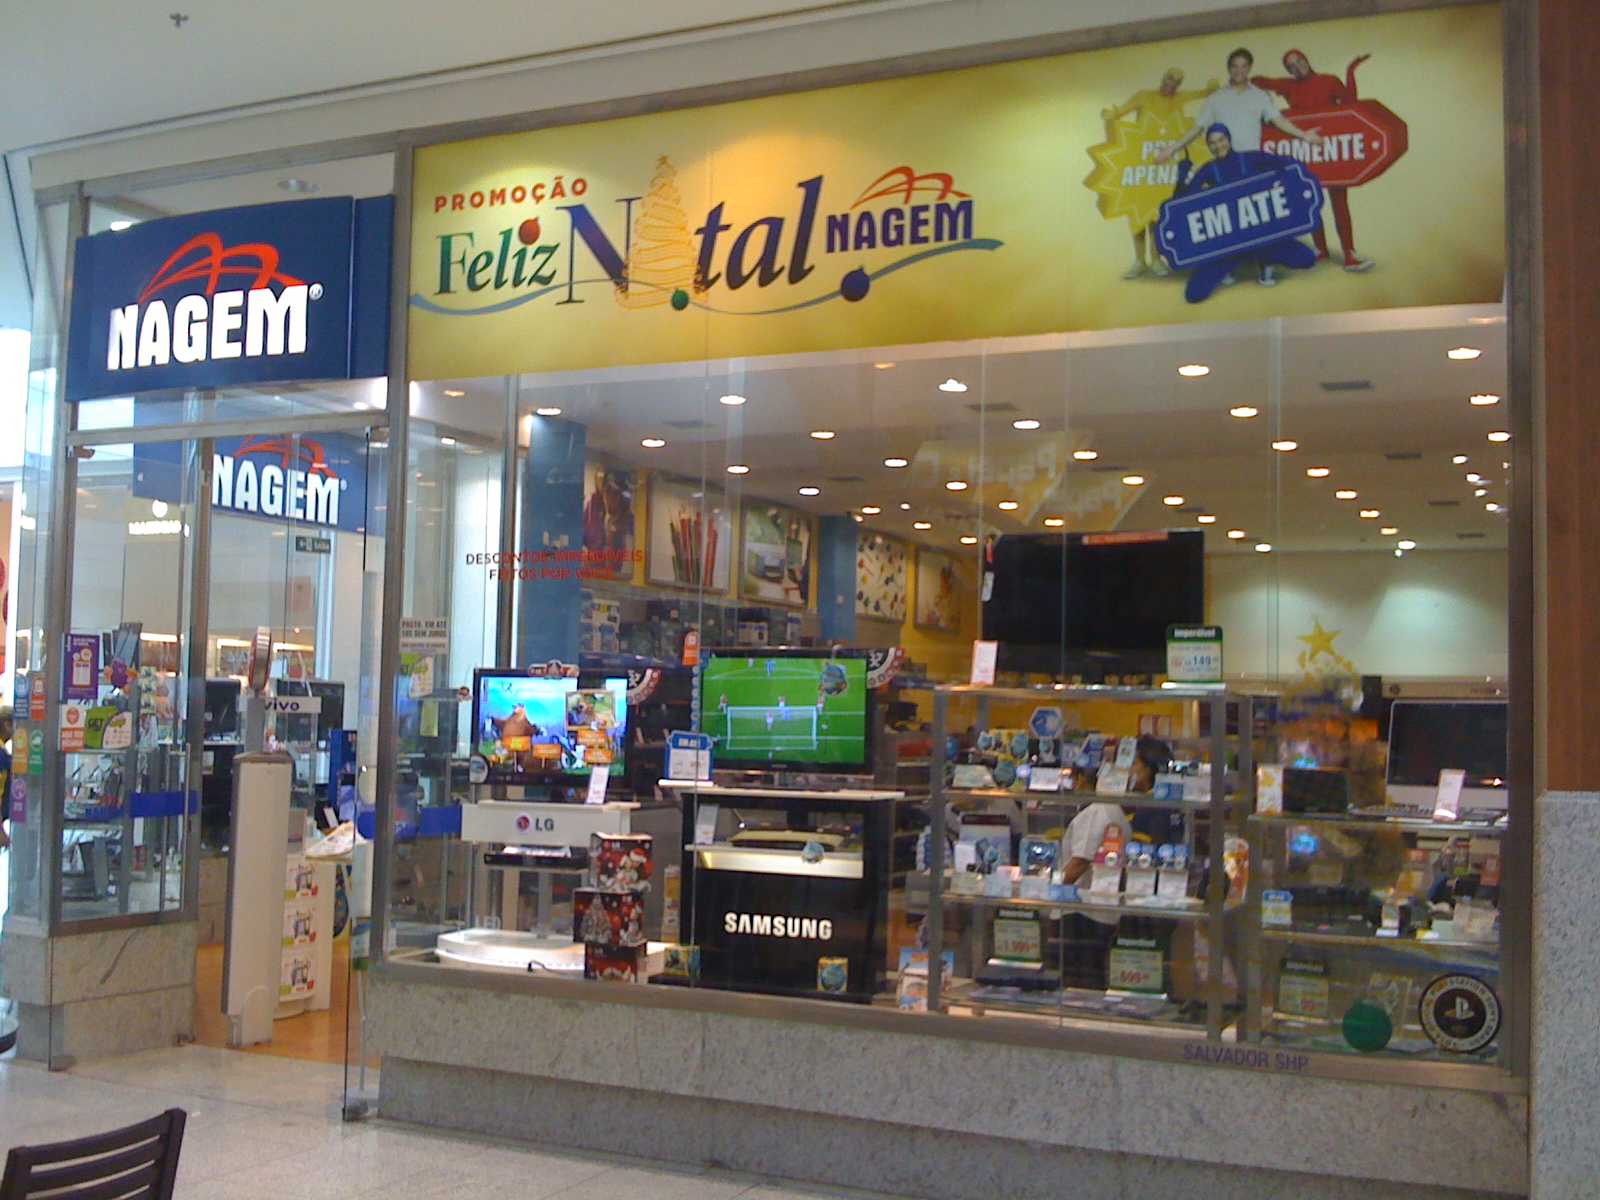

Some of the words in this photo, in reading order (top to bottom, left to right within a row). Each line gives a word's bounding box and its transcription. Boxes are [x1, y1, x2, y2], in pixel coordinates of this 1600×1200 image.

[434, 175, 590, 213] PROMOÇÃO
[826, 200, 973, 254] NAGEM
[1186, 199, 1233, 244] EM
[1237, 181, 1291, 230] ATÉ
[435, 219, 561, 297] Feliz
[106, 285, 309, 371] NAGEM
[212, 454, 339, 525] NAGEM
[466, 550, 548, 565] DESCONTOS
[489, 567, 537, 580] FEITOS
[541, 567, 570, 580] POR
[264, 698, 300, 711] vivo
[535, 818, 555, 831] LG
[724, 912, 833, 941] SAMSUNG
[1183, 1043, 1270, 1067] SALVADOR
[1276, 1052, 1309, 1071] SHP
